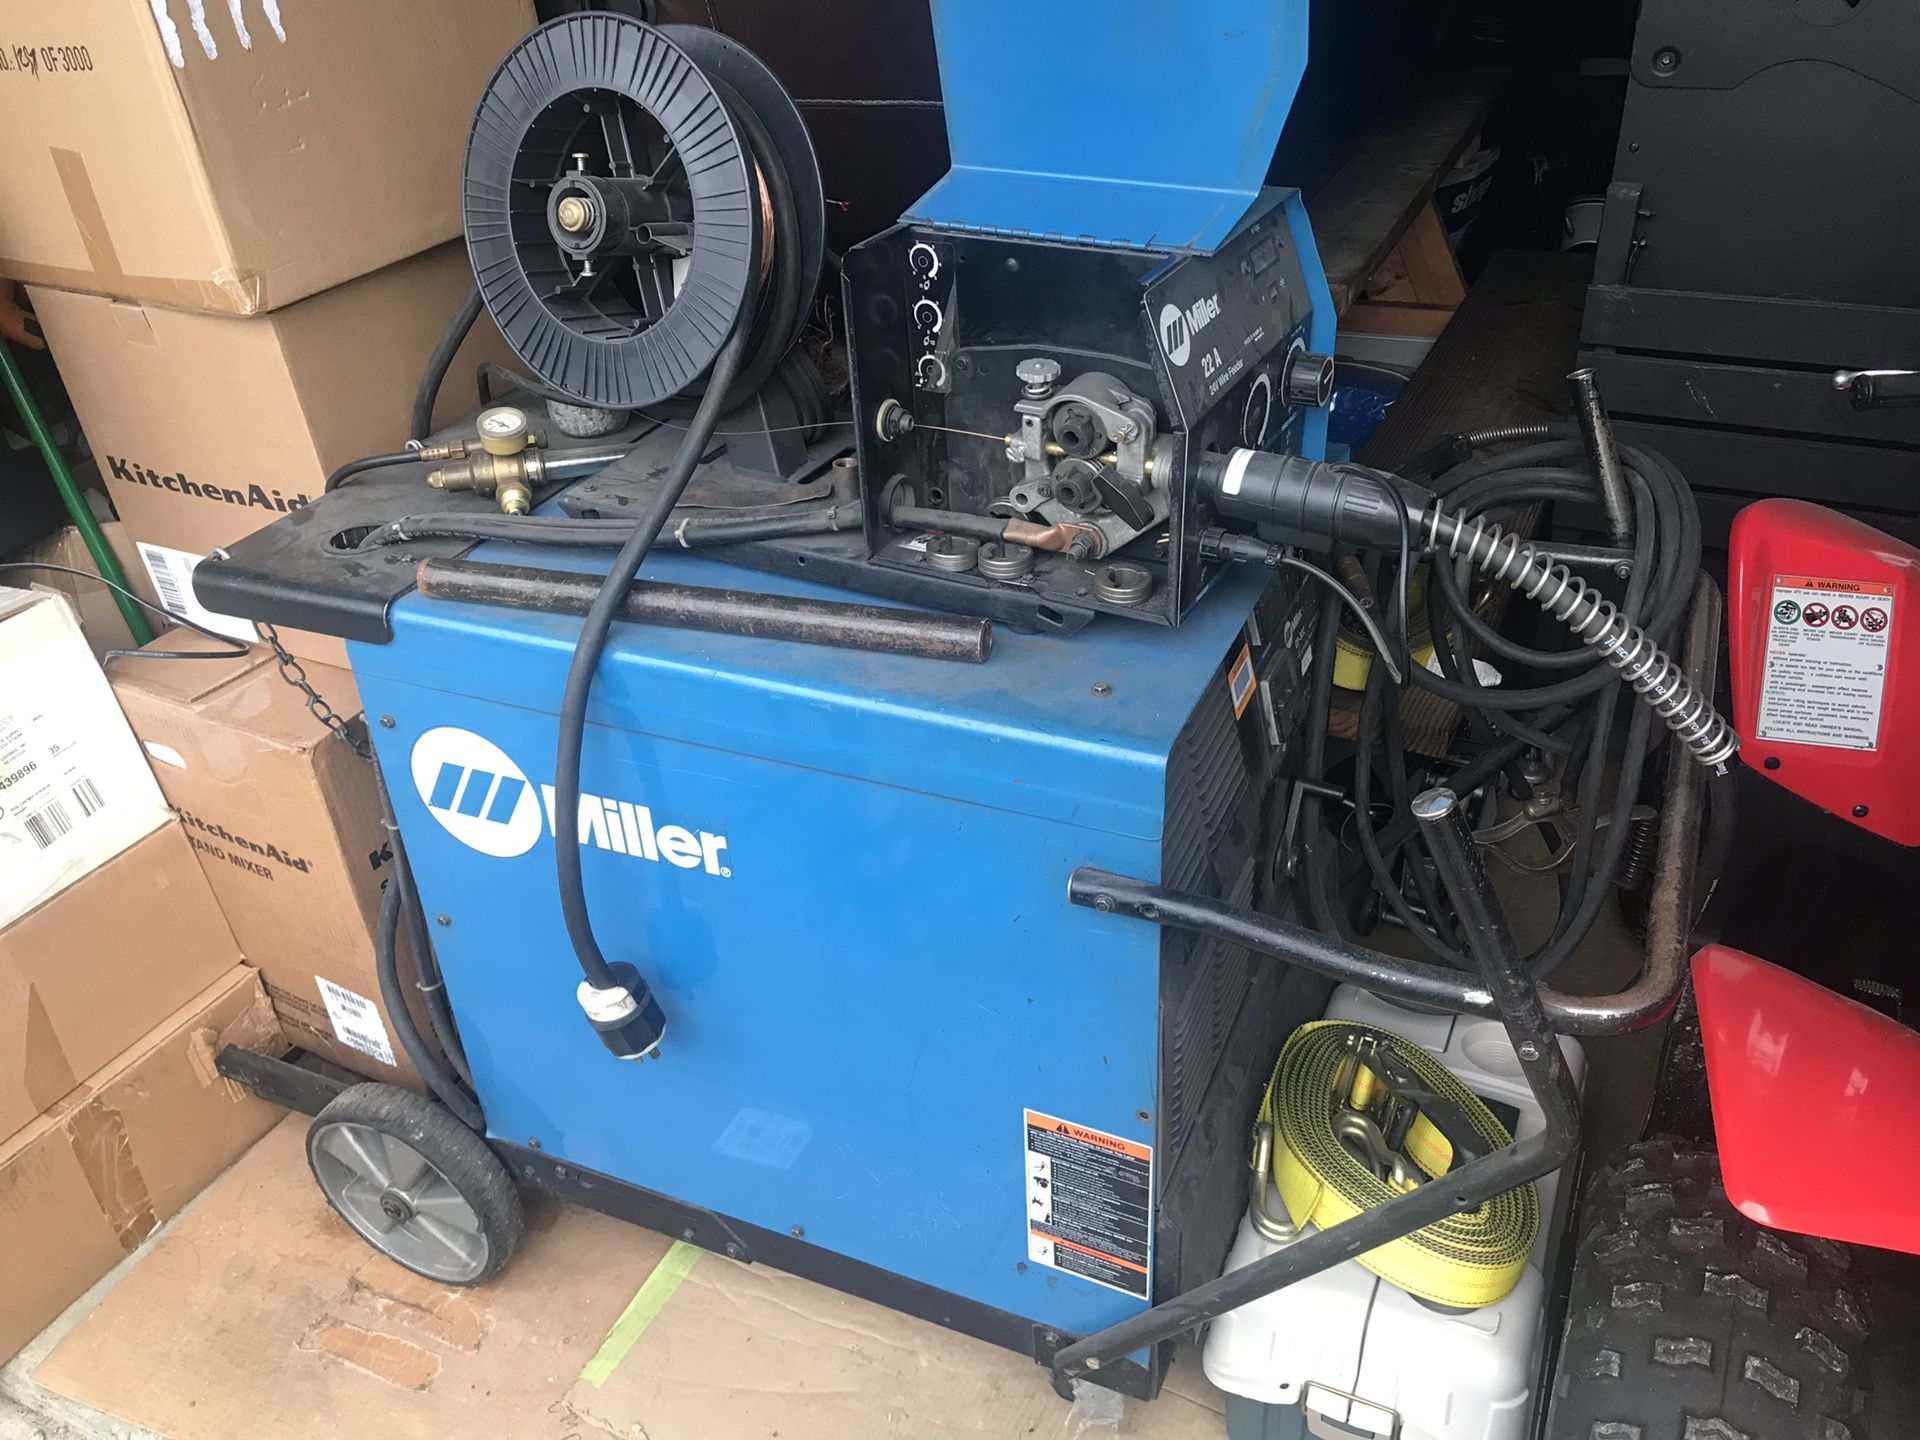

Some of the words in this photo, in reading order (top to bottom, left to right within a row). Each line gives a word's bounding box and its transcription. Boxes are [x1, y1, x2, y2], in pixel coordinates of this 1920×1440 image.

[40, 46, 58, 72] OF
[57, 45, 93, 72] 3000
[1185, 293, 1221, 336] Miller
[1201, 353, 1215, 378] 22
[1213, 347, 1222, 368] A
[1209, 379, 1219, 396] 24V
[1217, 372, 1229, 387] Wire
[1228, 358, 1244, 377] Feeder
[106, 455, 310, 513] KitchenAid
[1817, 581, 1860, 591] WARNING
[541, 783, 728, 877] Miller
[187, 835, 225, 860] TAND
[228, 852, 274, 881] MIXER
[1073, 1128, 1126, 1151] WARNING
